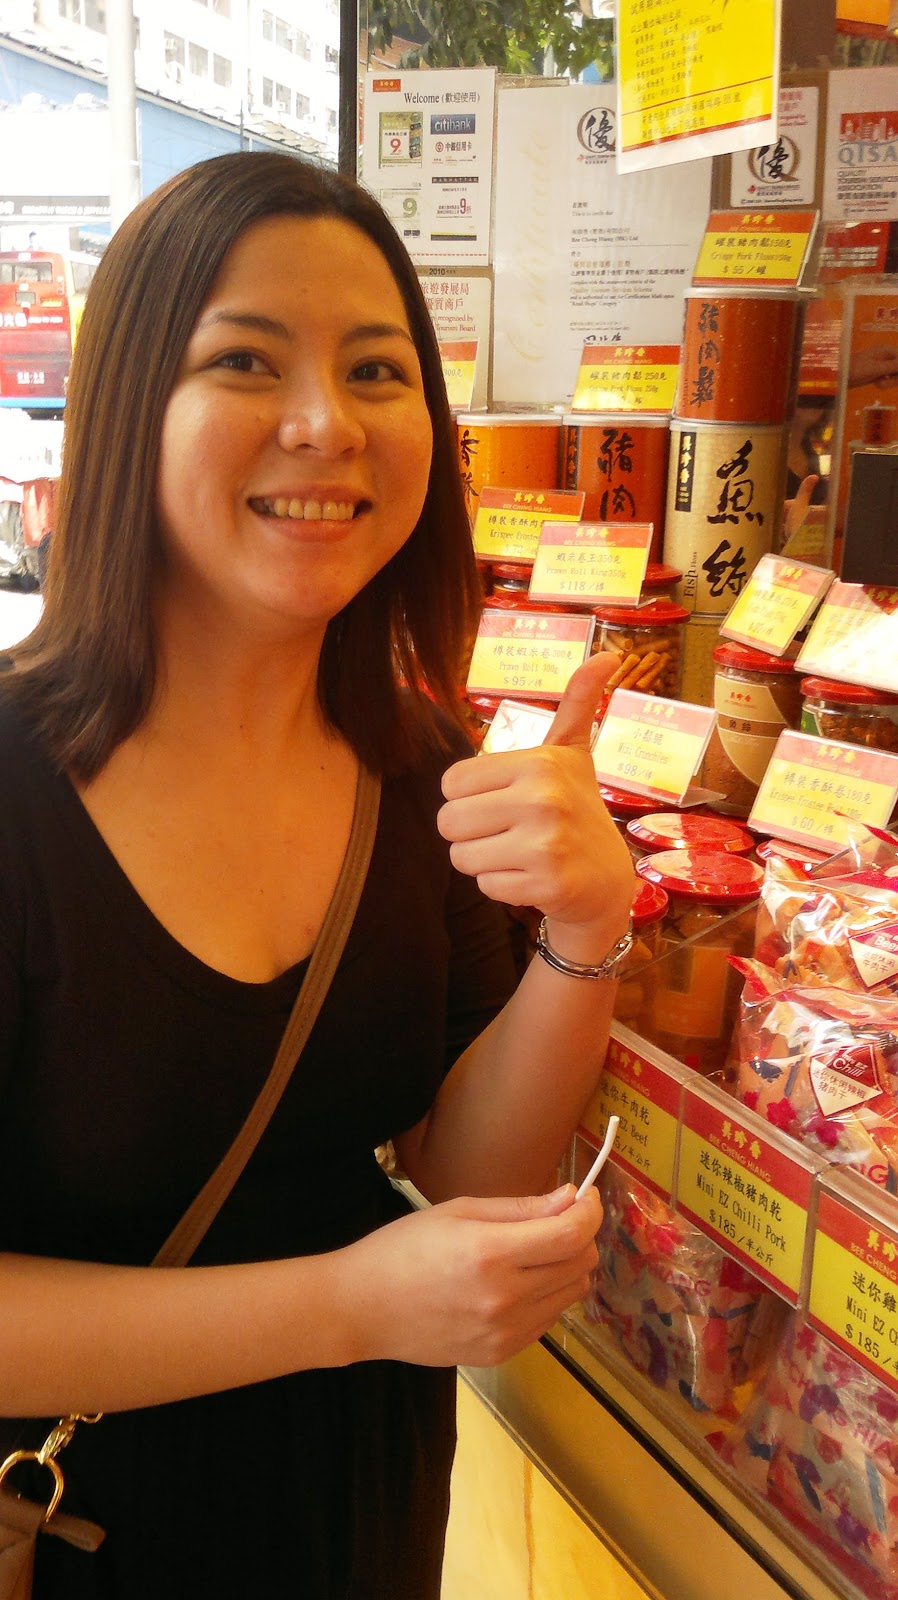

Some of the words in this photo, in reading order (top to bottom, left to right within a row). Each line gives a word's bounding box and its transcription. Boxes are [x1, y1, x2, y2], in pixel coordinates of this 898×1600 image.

[404, 92, 439, 104] Welcome
[435, 117, 471, 132] citibank
[585, 110, 614, 149] 優
[838, 145, 898, 166] QTSA
[428, 268, 446, 276] 2010
[460, 324, 476, 332] Board
[488, 514, 542, 528] 樽裝香酥肉
[546, 567, 567, 575] Prawn
[570, 567, 587, 575] Roll
[684, 569, 698, 598] Fish
[499, 661, 520, 671] Prawn
[522, 662, 538, 672] Roll
[631, 1124, 649, 1147] Beef
[721, 1142, 747, 1166] CHENG
[746, 1160, 771, 1184] HIANG
[696, 1172, 715, 1198] Mini
[718, 1189, 730, 1209] EZ
[732, 1199, 762, 1233] Chilli
[766, 1225, 787, 1253] Pork
[850, 1243, 865, 1259] BEE
[865, 1253, 898, 1281] CHENG
[852, 1270, 897, 1314] 迷你雞
[846, 1295, 868, 1324] Mini
[872, 1314, 887, 1336] EZ
